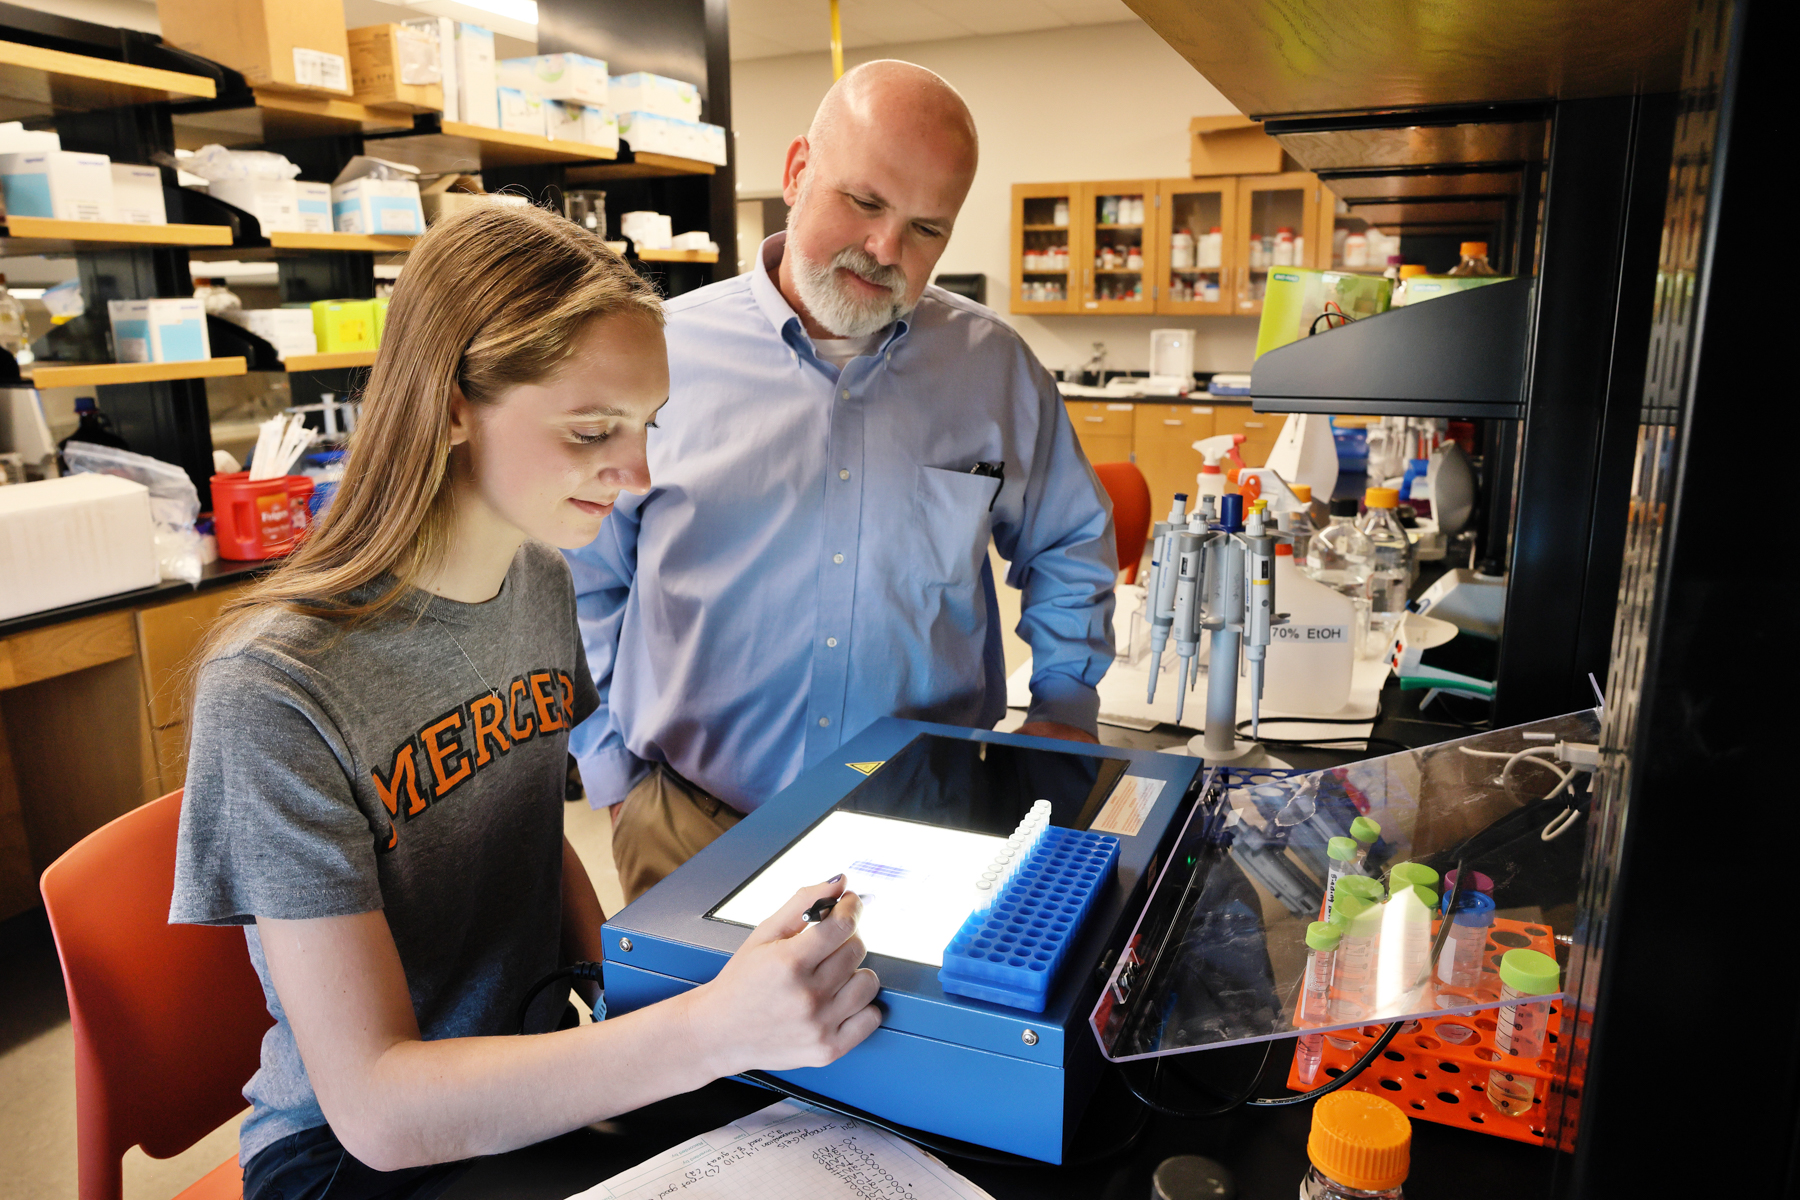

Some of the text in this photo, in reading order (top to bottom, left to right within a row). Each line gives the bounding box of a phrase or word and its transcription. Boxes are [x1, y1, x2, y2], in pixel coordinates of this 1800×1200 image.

[1273, 628, 1341, 640] 70% EtOH
[370, 668, 575, 850] MERCER
